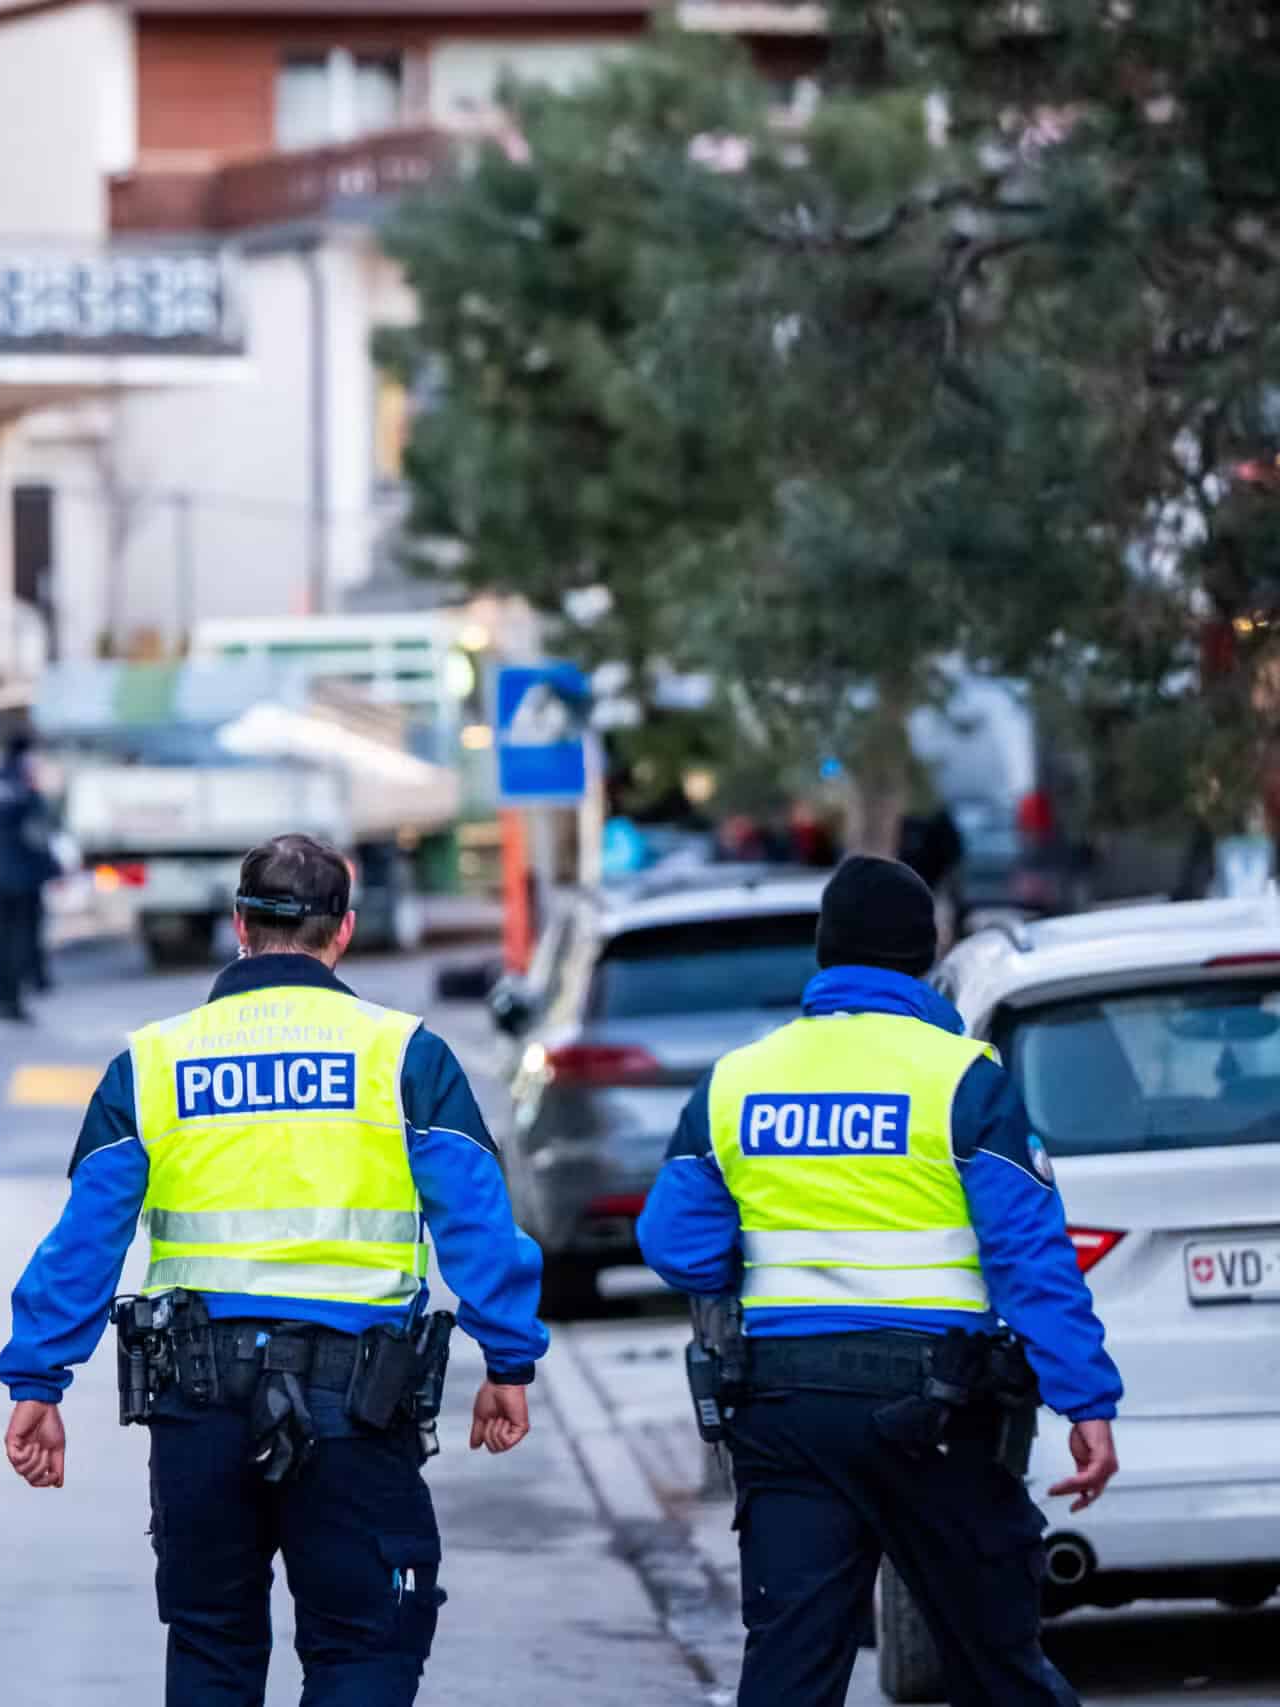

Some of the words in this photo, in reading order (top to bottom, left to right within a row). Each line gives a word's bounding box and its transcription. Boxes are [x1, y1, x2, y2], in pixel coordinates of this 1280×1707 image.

[238, 1001, 296, 1024] CHEF
[182, 1057, 349, 1111] POLICE
[748, 1102, 899, 1150] POLICE
